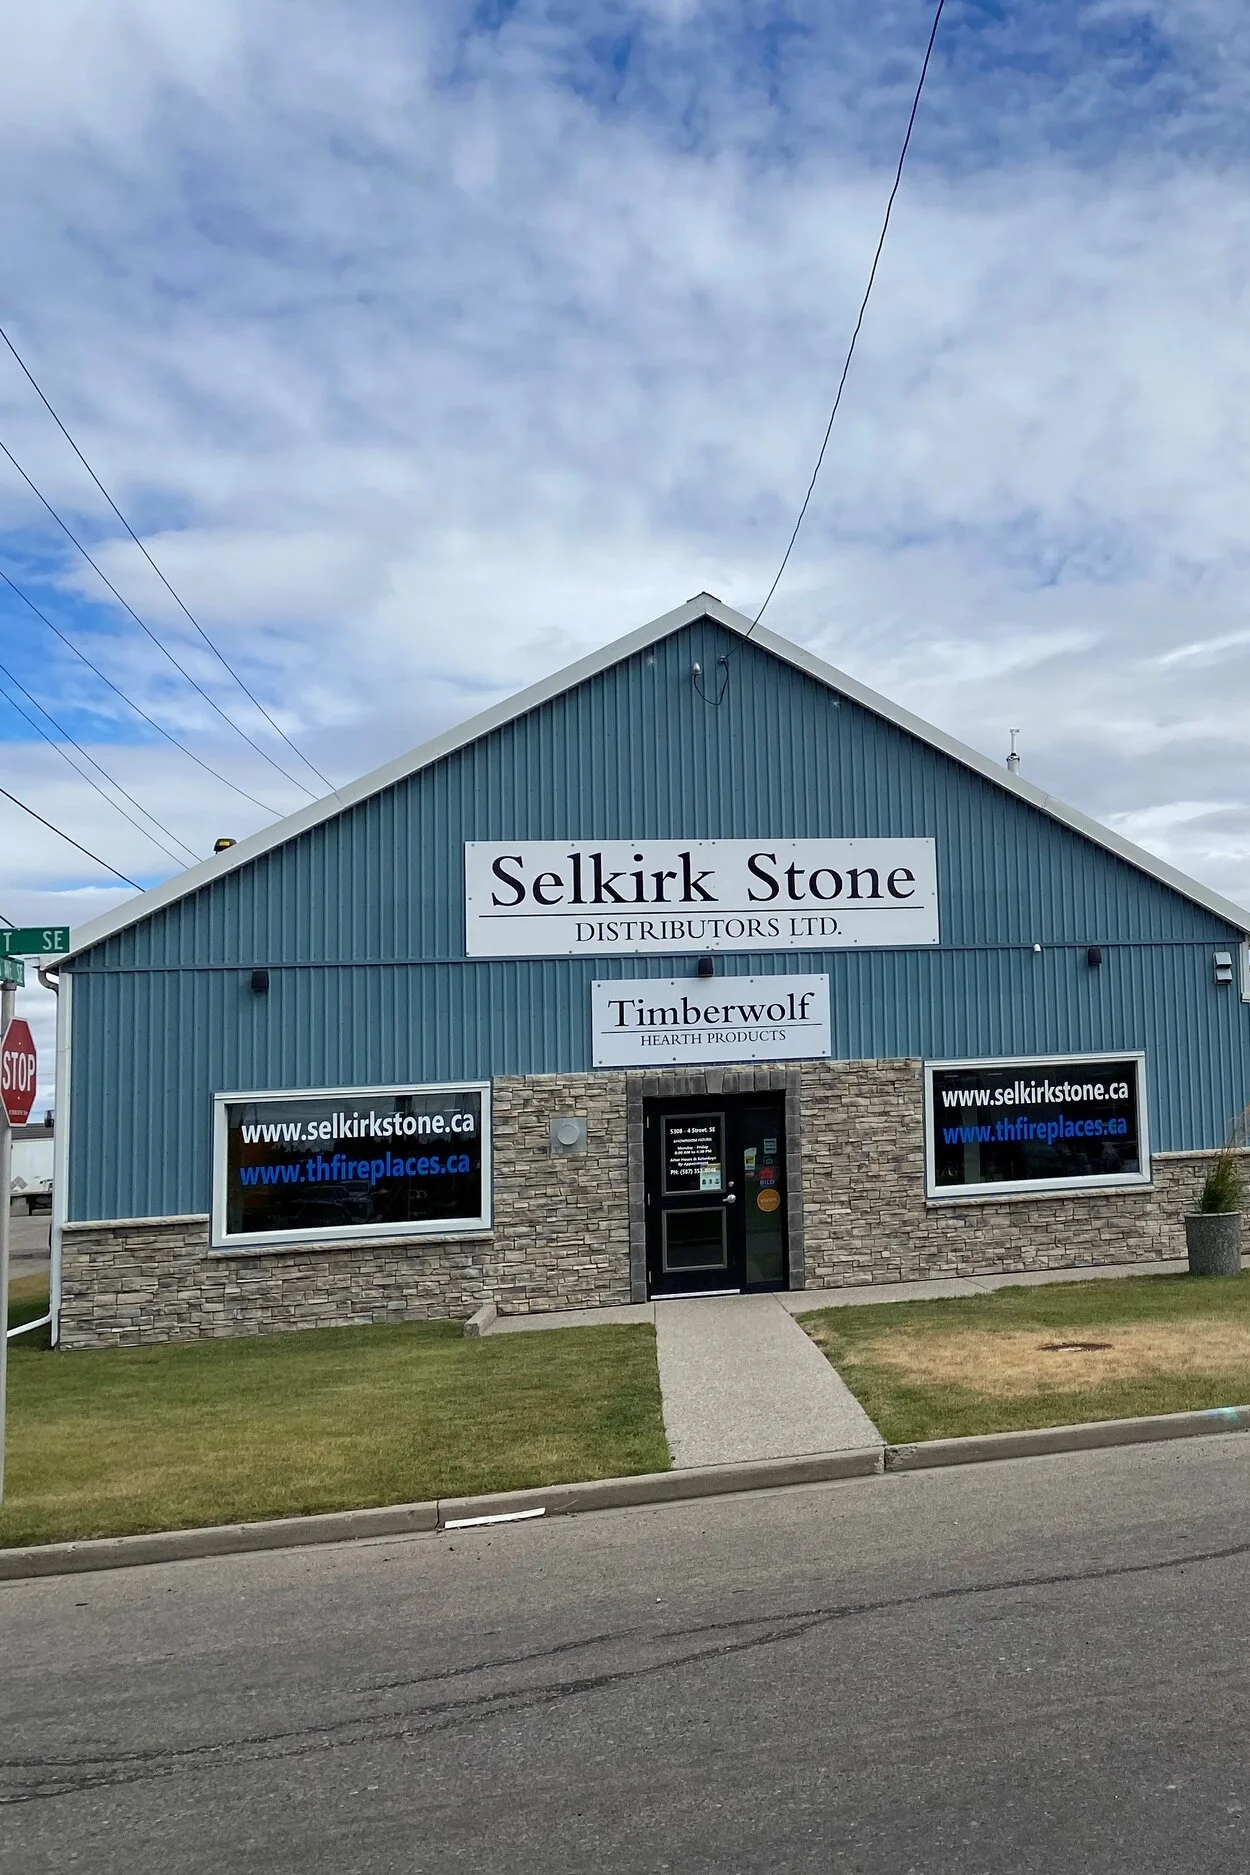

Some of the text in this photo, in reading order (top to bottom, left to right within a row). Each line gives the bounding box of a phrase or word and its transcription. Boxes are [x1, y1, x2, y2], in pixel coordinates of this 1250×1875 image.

[491, 852, 916, 907] Selkirk Stone
[42, 930, 63, 950] SE
[575, 916, 842, 942] DISTRIBUTORS LTD.
[607, 991, 815, 1027] Timberwolf
[640, 1029, 786, 1047] HEARTH PRODUCTS
[2, 1050, 36, 1092] STOP
[942, 1079, 1129, 1108] www.selkirkstone.ca
[241, 1110, 475, 1144] www.selkirkstone.ca
[943, 1114, 1127, 1145] www.thfireplaces.ca
[240, 1151, 470, 1186] www.thfireplaces.ca
